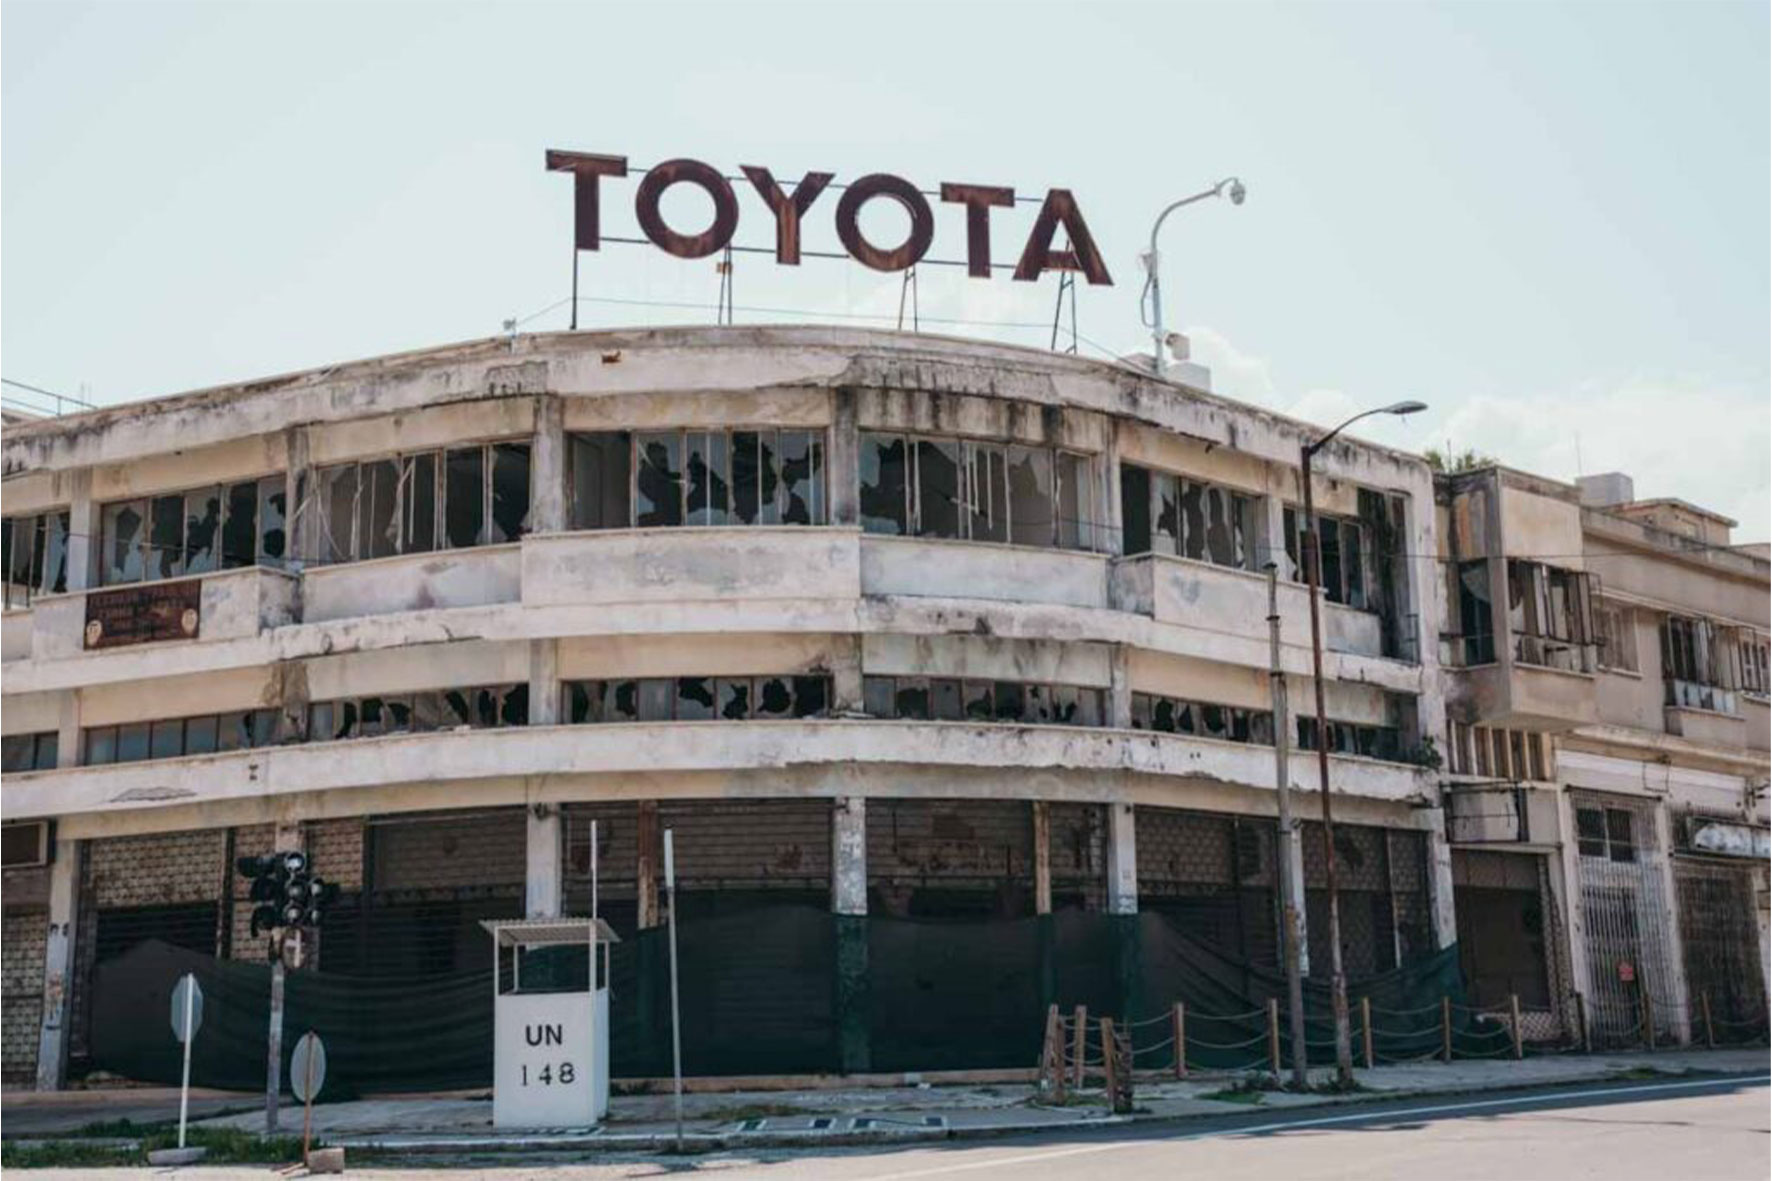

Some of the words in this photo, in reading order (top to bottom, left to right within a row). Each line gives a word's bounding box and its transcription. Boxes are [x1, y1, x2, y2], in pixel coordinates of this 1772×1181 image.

[545, 149, 1114, 286] TOYOTA
[525, 1023, 563, 1046] UN
[522, 1062, 575, 1087] 148
